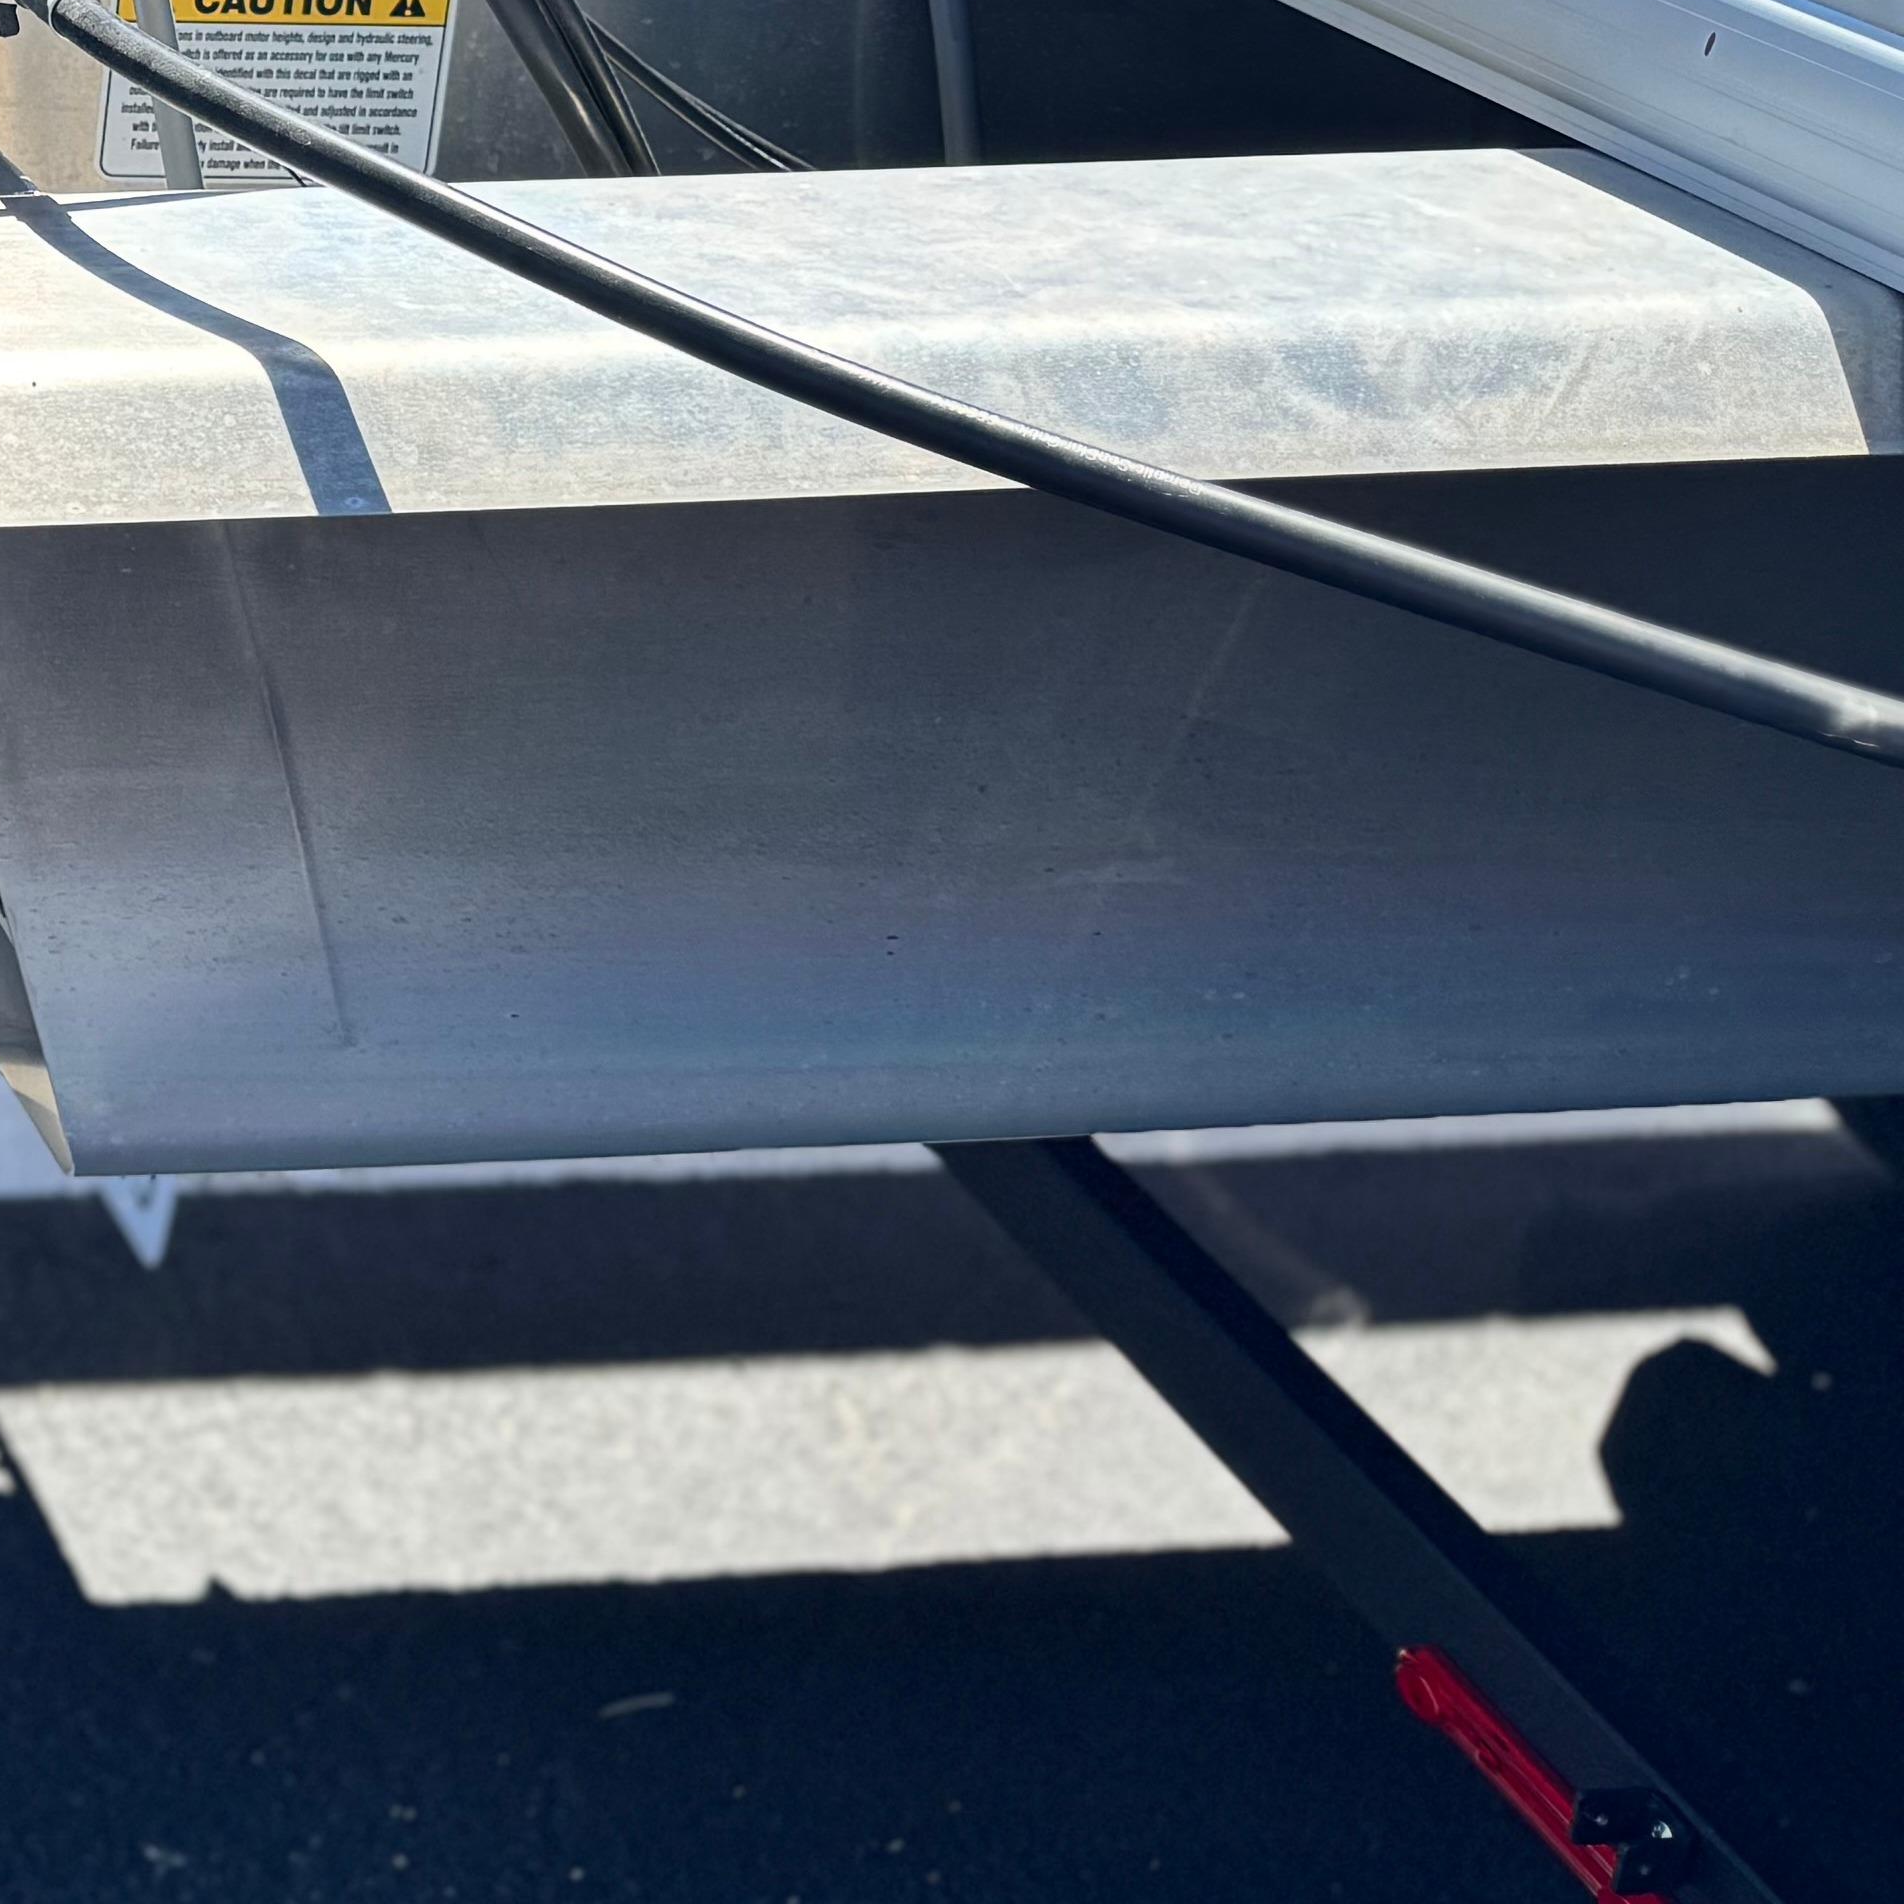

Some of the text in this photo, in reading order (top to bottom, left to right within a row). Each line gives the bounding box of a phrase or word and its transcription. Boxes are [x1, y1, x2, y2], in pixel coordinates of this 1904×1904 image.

[205, 30, 243, 42] outboard
[245, 31, 270, 42] motor
[307, 32, 336, 45] design
[337, 32, 354, 43] and
[355, 32, 394, 46] hydraulic
[212, 48, 243, 60] offered
[270, 51, 313, 64] accessory
[315, 51, 327, 62] for
[329, 53, 344, 62] use
[346, 51, 364, 62] with
[366, 53, 382, 65] any
[384, 51, 420, 66] Mercury
[256, 68, 273, 79] with
[275, 68, 291, 79] this
[293, 68, 317, 79] decal
[318, 69, 335, 80] that
[337, 71, 351, 81] are
[353, 69, 380, 83] rigged
[382, 70, 400, 81] with
[402, 72, 413, 81] an
[264, 88, 277, 98] are
[279, 87, 315, 101] required
[317, 87, 326, 98] to
[328, 87, 348, 99] have
[350, 87, 363, 99] the
[365, 87, 385, 99] limit
[386, 88, 414, 100] switch
[303, 105, 319, 116] and
[320, 105, 357, 118] adjusted
[358, 105, 367, 117] in
[368, 106, 418, 118] accordance
[132, 120, 150, 132] with
[351, 124, 371, 135] limit
[207, 158, 241, 171] damage
